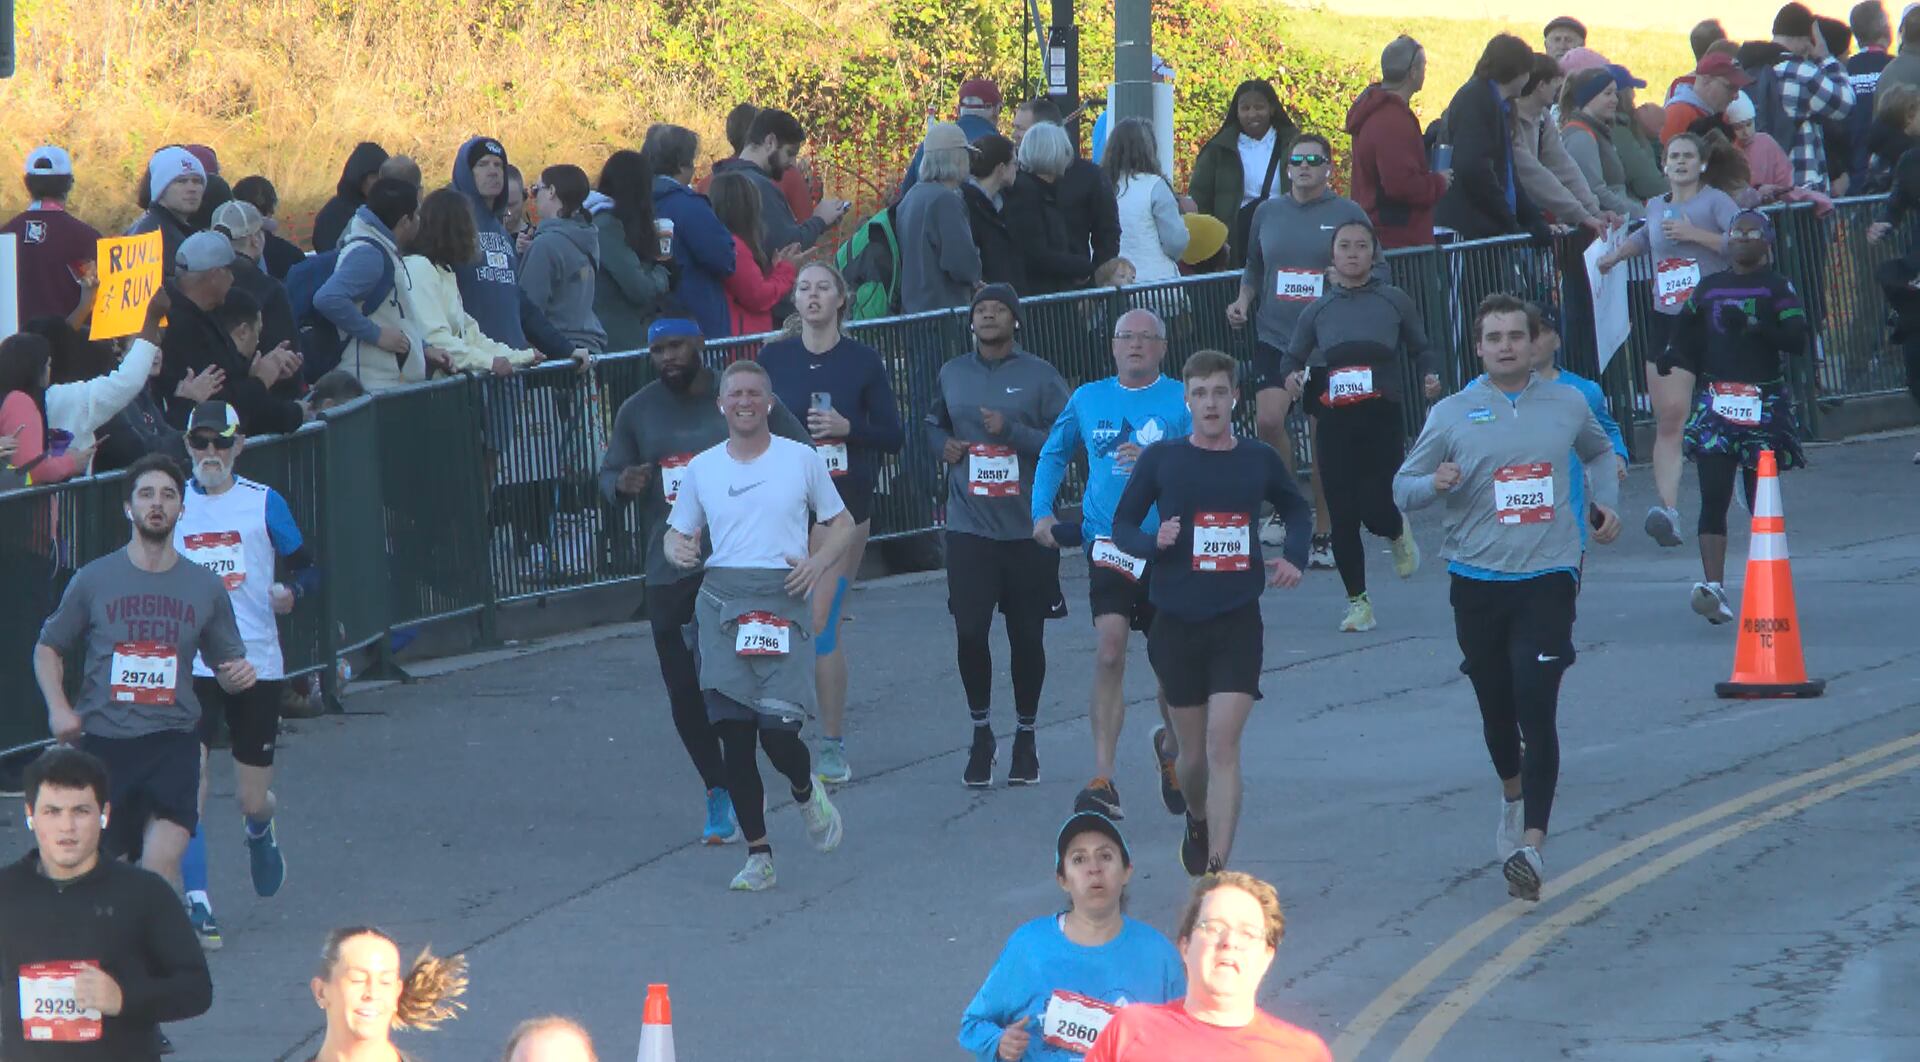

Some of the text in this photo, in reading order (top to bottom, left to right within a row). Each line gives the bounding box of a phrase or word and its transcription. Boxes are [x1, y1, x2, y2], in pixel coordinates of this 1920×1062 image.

[121, 270, 154, 310] RUN
[1666, 275, 1692, 291] 27442
[1505, 491, 1544, 507] 26223
[105, 594, 197, 628] VIRGINIA
[124, 619, 180, 644] TECH
[1754, 617, 1791, 633] BROOKS
[1760, 634, 1773, 649] TC
[121, 670, 164, 685] 29744
[1056, 1018, 1099, 1043] 2860
